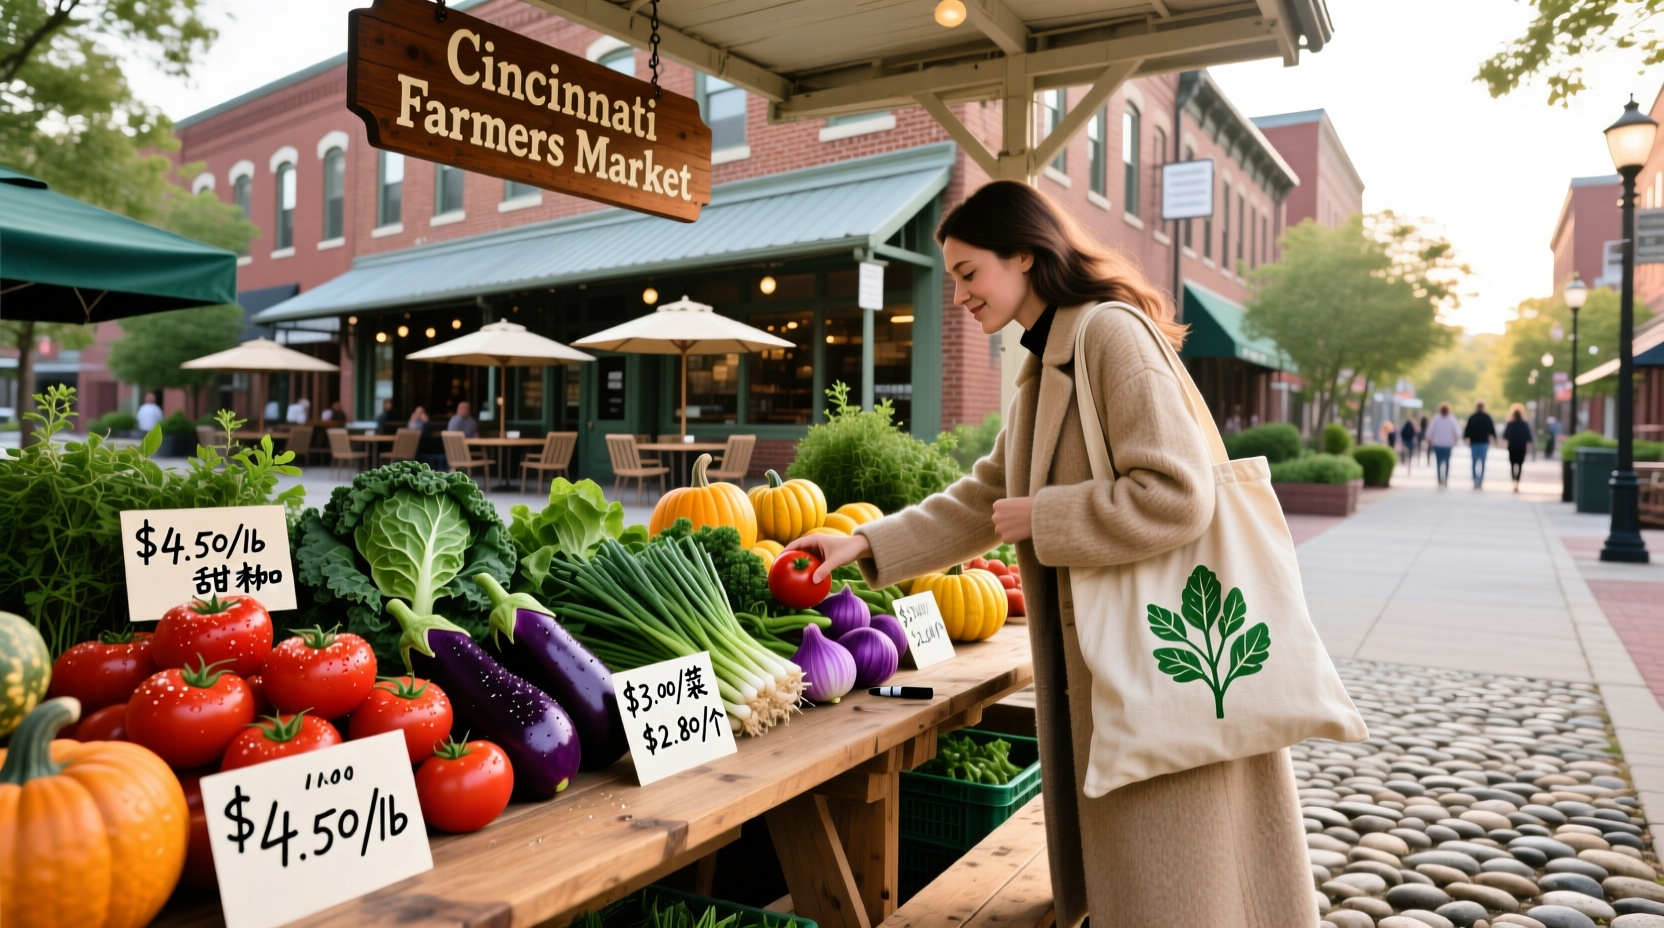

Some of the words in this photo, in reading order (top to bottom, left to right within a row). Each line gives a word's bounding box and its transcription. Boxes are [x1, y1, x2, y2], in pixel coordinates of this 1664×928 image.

[447, 28, 657, 142] Cincinnati
[396, 74, 564, 167] Farmers
[574, 128, 692, 201] Market
[135, 518, 266, 566] $4.50/lb
[623, 665, 708, 719] $3.00/菜
[224, 784, 408, 868] $4.50/lb
